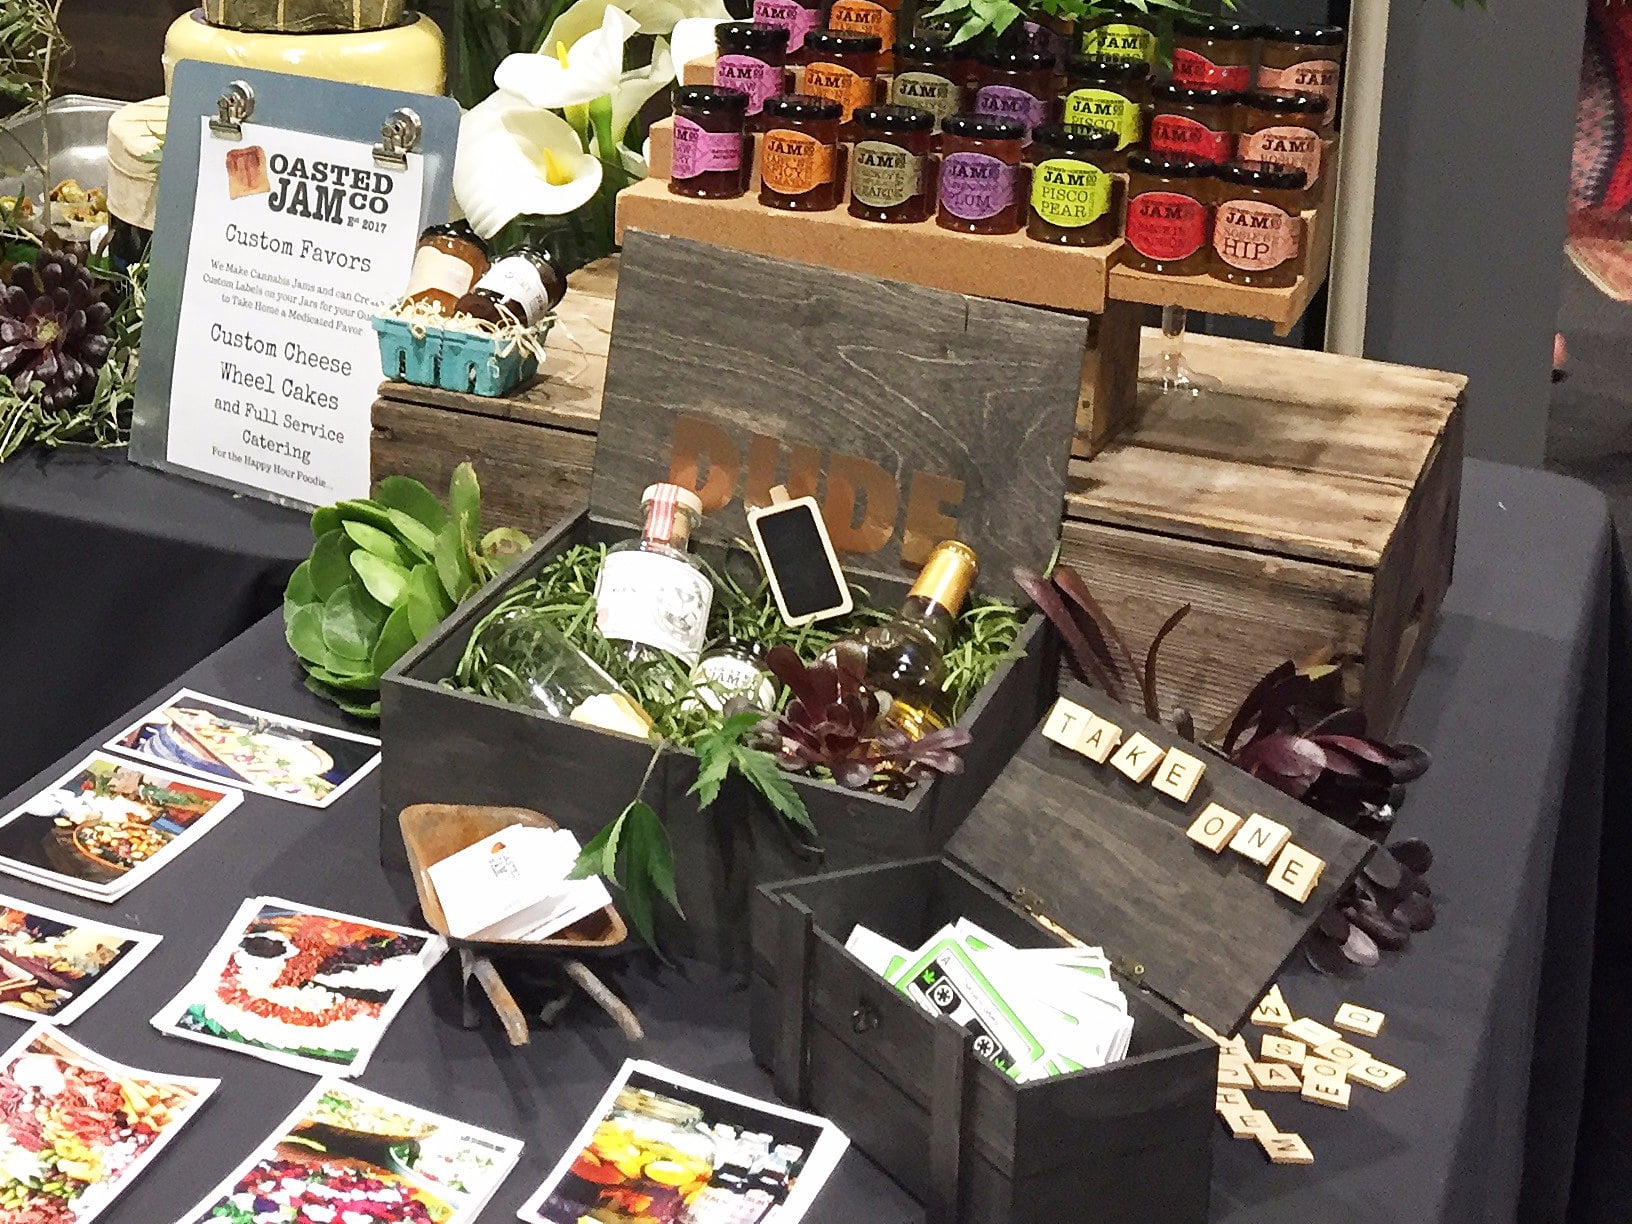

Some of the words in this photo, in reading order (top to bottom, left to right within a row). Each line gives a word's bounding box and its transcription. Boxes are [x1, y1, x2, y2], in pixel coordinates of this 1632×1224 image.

[756, 5, 786, 20] JAM
[835, 9, 870, 24] JAM
[1097, 36, 1138, 50] JAM
[718, 66, 752, 80] JAM
[807, 73, 840, 88] JAM
[899, 82, 935, 98] JAM
[981, 96, 1018, 112] JAM
[1073, 101, 1111, 115] JAM
[768, 141, 803, 156] JAM
[1261, 139, 1305, 153] JAM
[857, 153, 894, 168] JAM
[951, 165, 987, 179] JAM
[1043, 171, 1085, 186] JAM
[268, 177, 347, 225] JAM
[349, 192, 389, 214] CO
[1042, 186, 1088, 204] PISCO
[1041, 201, 1087, 218] PEAR
[1140, 205, 1183, 220] JAM
[362, 219, 388, 234] 2017
[1226, 212, 1269, 229] JAM
[225, 223, 294, 256] Custom
[300, 239, 372, 272] Favors
[1223, 237, 1270, 260] HIP
[210, 259, 224, 271] We
[225, 263, 248, 277] Make
[250, 269, 290, 286] Cannabis
[292, 278, 316, 292] Jams
[316, 286, 334, 296] and
[335, 290, 352, 301] can
[202, 272, 234, 289] Custom
[235, 280, 263, 296] Labels
[264, 290, 276, 299] on
[276, 292, 298, 304] your
[298, 296, 318, 308] Jars
[319, 300, 333, 312] for
[334, 306, 356, 317] your
[221, 293, 231, 303] to
[232, 295, 253, 309] Take
[255, 301, 280, 315] Home
[281, 310, 287, 318] a
[288, 309, 334, 329] Medicated
[336, 320, 364, 336] Favor
[211, 323, 278, 358] Custom
[284, 342, 352, 377] Cheese
[220, 361, 276, 394] Wheel
[282, 378, 340, 411] Cakes
[214, 398, 240, 416] and
[244, 402, 279, 426] Full
[283, 414, 345, 444] Service
[242, 429, 312, 465] Catering
[212, 446, 227, 458] For
[228, 449, 243, 463] the
[244, 454, 271, 474] Happy
[273, 463, 296, 479] Hour
[1060, 711, 1188, 788] TAKE
[1202, 814, 1305, 887] ONE
